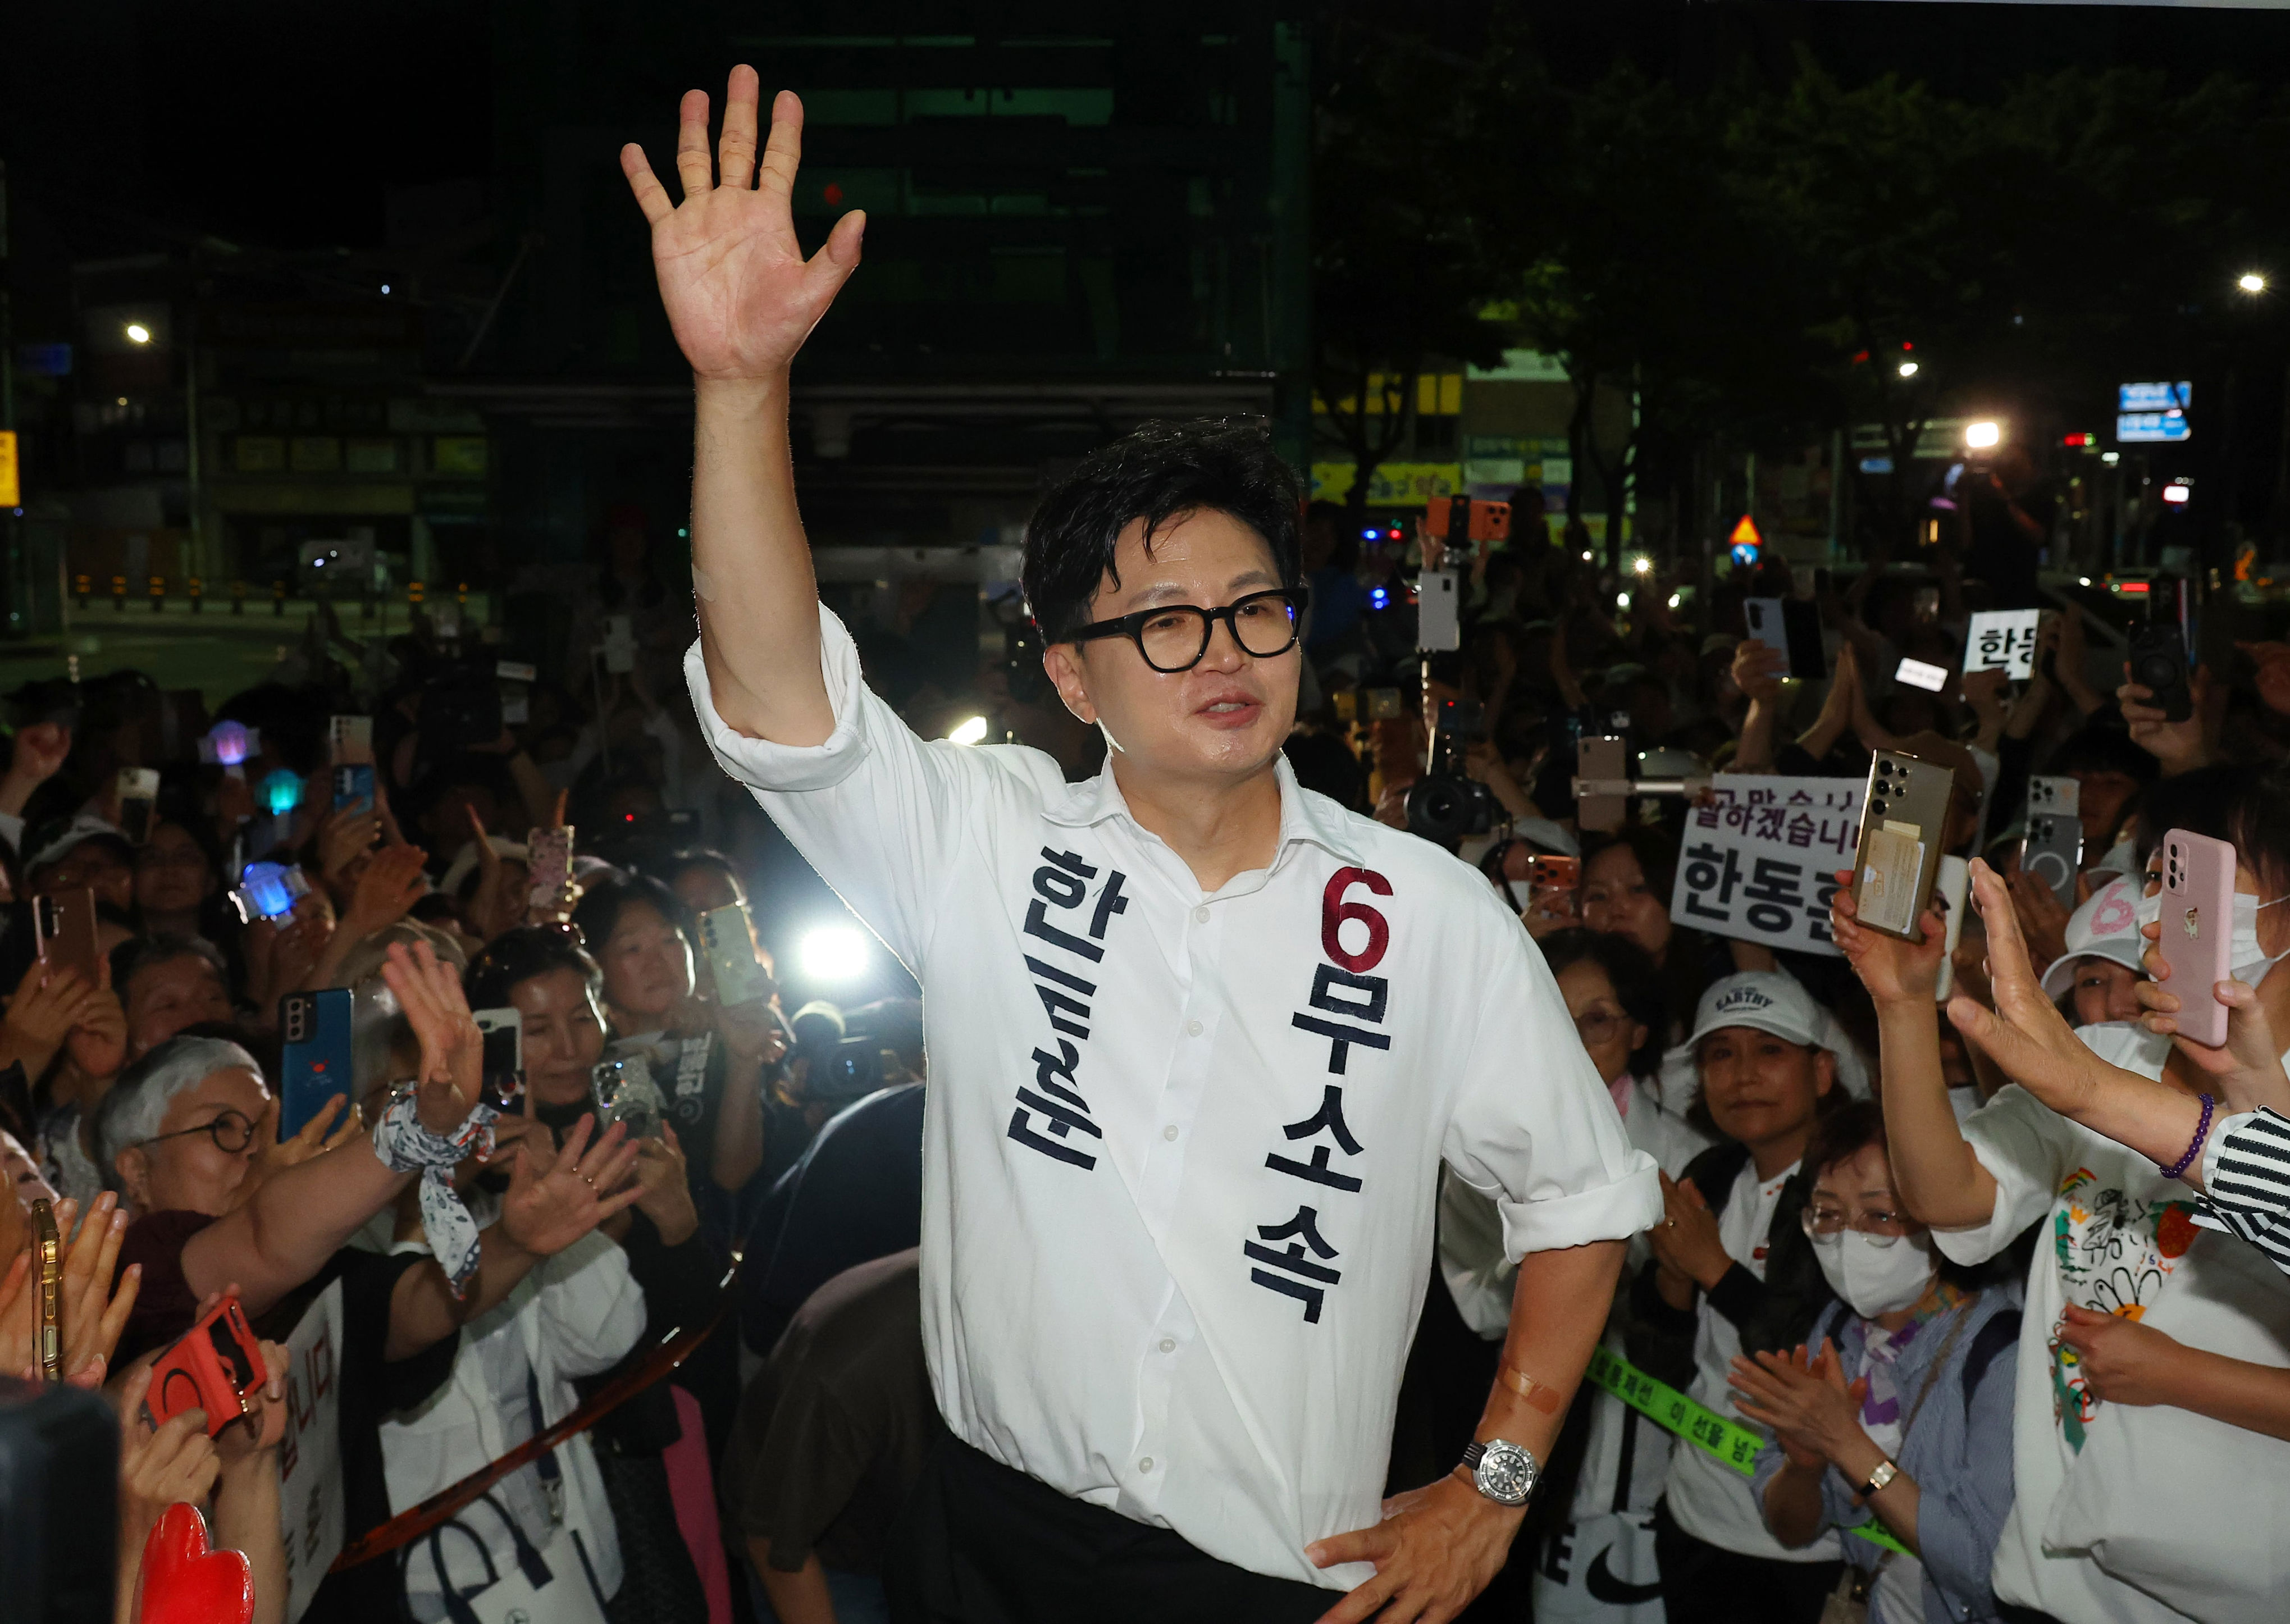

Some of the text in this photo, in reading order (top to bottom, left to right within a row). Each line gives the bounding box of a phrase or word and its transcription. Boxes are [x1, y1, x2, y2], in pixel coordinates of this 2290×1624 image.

[1696, 804, 1861, 855] 하겠습니
[2090, 882, 2134, 936] 6
[1244, 866, 1394, 1324] 6 무소속
